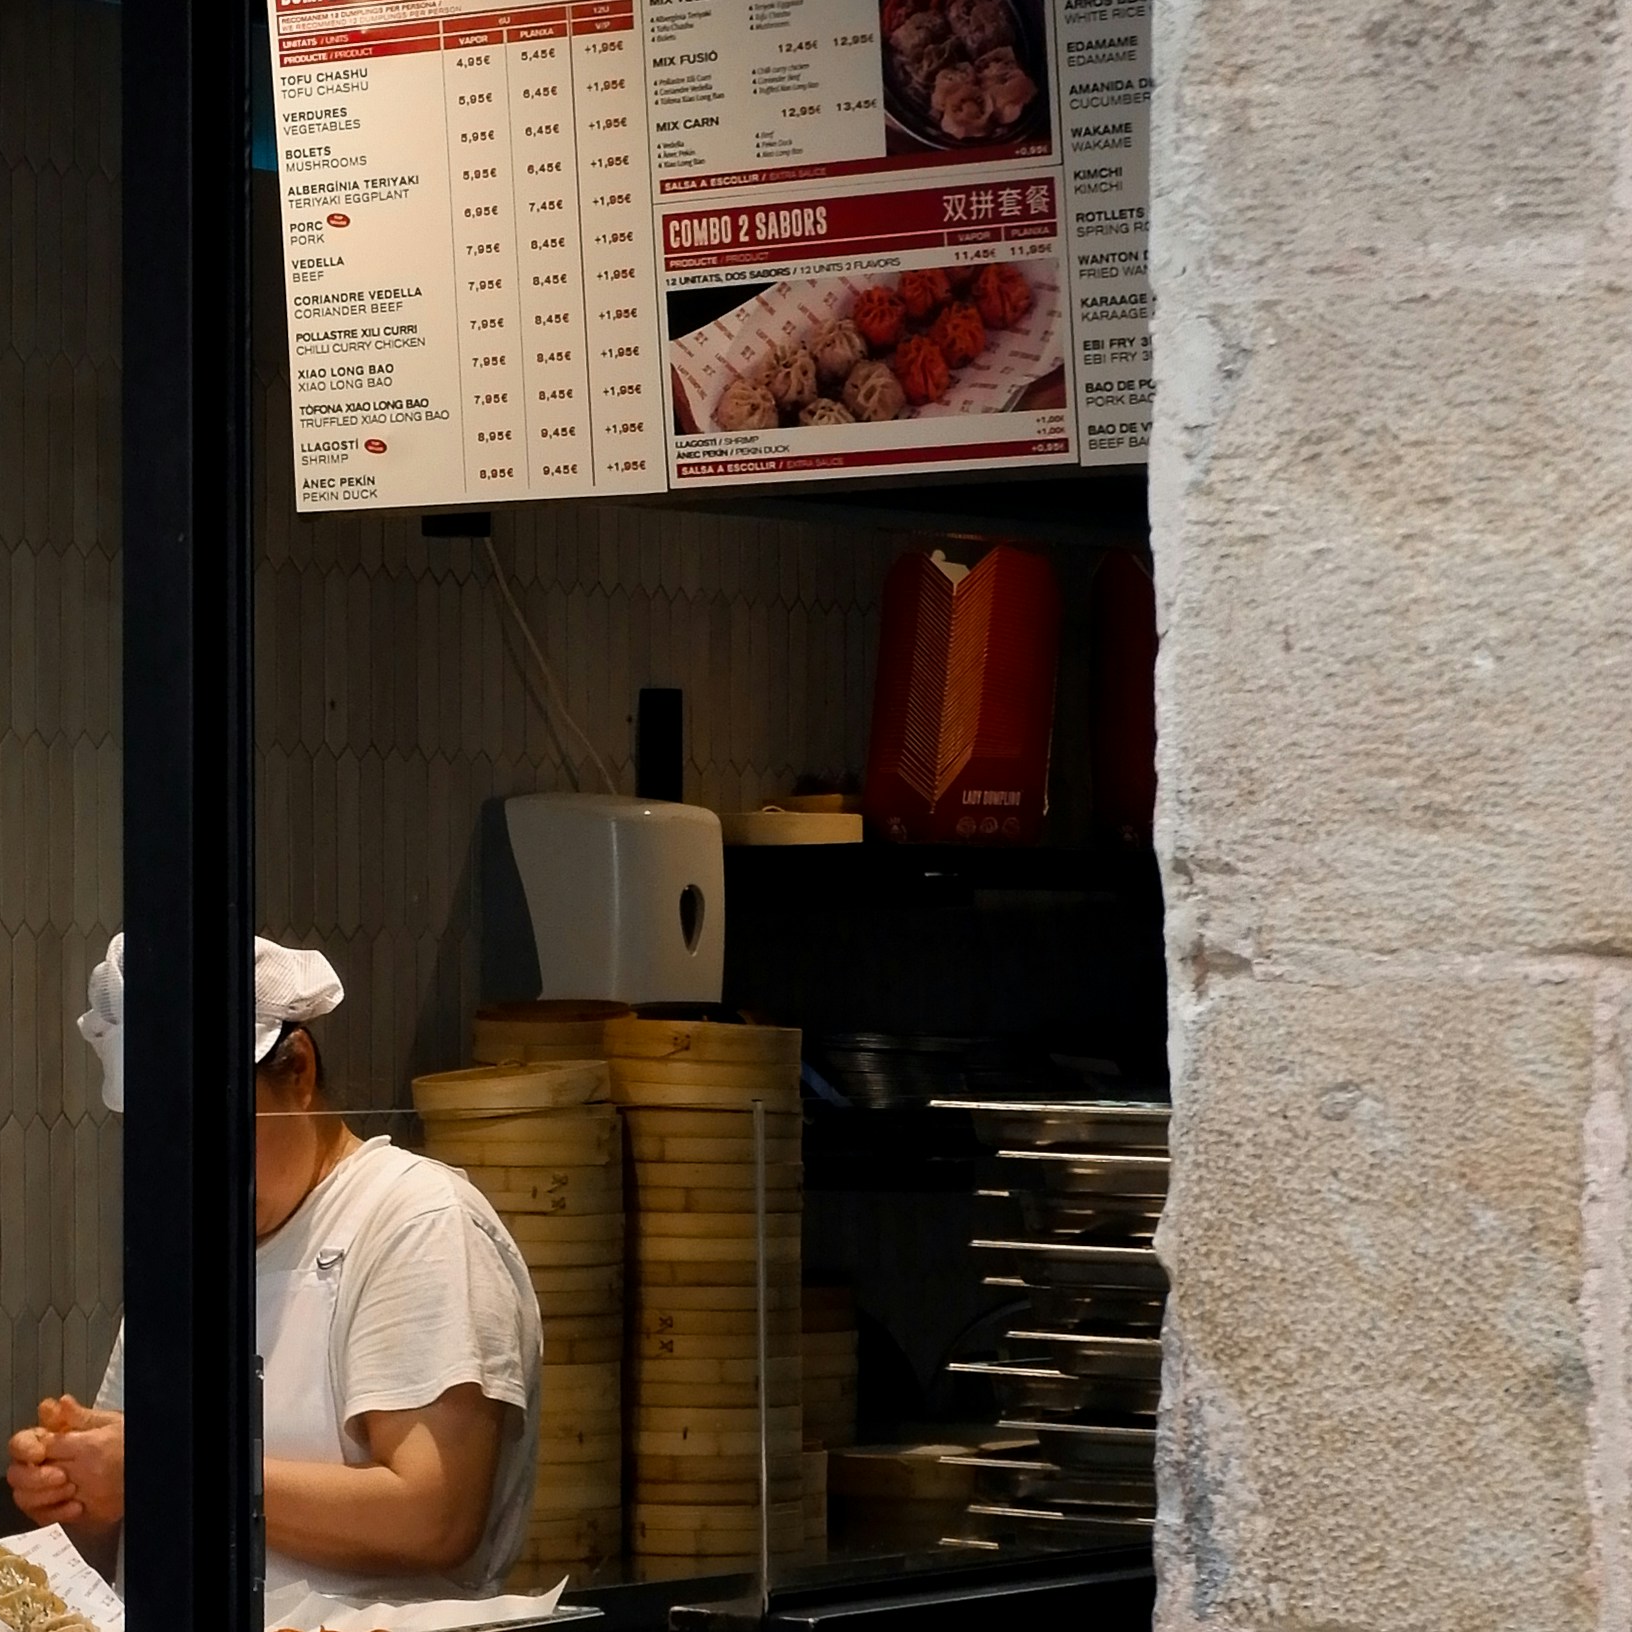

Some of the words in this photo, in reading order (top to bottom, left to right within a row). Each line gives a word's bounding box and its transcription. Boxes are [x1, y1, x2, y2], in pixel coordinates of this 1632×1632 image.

[1066, 35, 1137, 52] EDAMAME
[456, 54, 490, 68] 4,95€
[1067, 49, 1136, 67] EDAMAME
[280, 73, 311, 86] TOFU
[316, 67, 367, 82] CHASHU
[280, 86, 312, 99] TOFU
[316, 81, 368, 95] CHASHU
[1069, 79, 1134, 95] AMANIDA
[458, 92, 492, 105] 5,95€
[282, 107, 347, 122] VERDURES
[283, 118, 360, 135] VEGETABLES
[656, 120, 679, 132] MIX
[682, 116, 719, 129] CARN
[1070, 122, 1132, 137] WAKAME
[460, 129, 494, 143] 5,95€
[1071, 136, 1131, 152] WAKAME
[285, 145, 331, 159] BOLETS
[285, 155, 366, 171] MUSHROOMS
[462, 167, 496, 181] 5,95€
[1073, 166, 1122, 180] KIMCHI
[287, 180, 359, 196] ALBERGÍNIA
[363, 174, 418, 188] TERIYAKI
[664, 180, 696, 191] SALSA
[699, 179, 707, 187] A
[710, 173, 758, 186] ESCOLLIR
[1074, 181, 1122, 194] KIMCHI
[288, 195, 340, 208] TERIYAKI
[344, 188, 409, 204] EGGPLANT
[942, 184, 1049, 221] 双拼套餐
[464, 205, 498, 218] 6,95€
[1075, 206, 1144, 222] ROTLLETS
[289, 220, 322, 232] PORC
[669, 215, 731, 248] COMBO
[738, 214, 749, 242] 2
[755, 206, 827, 240] SABORS
[1076, 222, 1129, 237] SPRING
[290, 233, 324, 245] PORK
[466, 242, 499, 256] 7,95€
[291, 256, 344, 269] VEDELLA
[1077, 251, 1138, 265] WANTON
[292, 270, 323, 282] BEEF
[1078, 266, 1118, 278] FRIED
[467, 278, 501, 291] 7,95€
[293, 291, 364, 306] CORIANDRE
[368, 286, 422, 300] VEDELLA
[1080, 293, 1147, 308] KARAAGE
[293, 304, 366, 319] CORIANDER
[370, 300, 402, 313] BEEF
[1081, 307, 1147, 321] KARAAGE
[469, 317, 503, 330] 7,95€
[295, 328, 357, 342] POLLASTRE
[360, 327, 380, 337] XILI
[383, 324, 417, 336] CURRI
[295, 344, 329, 355] CHILLI
[331, 340, 371, 353] CURRY
[374, 336, 425, 350] CHICKEN
[1083, 339, 1104, 350] EBI
[1109, 336, 1135, 348] FRY
[471, 355, 505, 368] 7,95€
[1083, 353, 1105, 365] EBI
[1110, 351, 1137, 362] FRY
[297, 368, 326, 379] XIAO
[330, 365, 364, 377] LONG
[368, 363, 394, 374] BAO
[298, 380, 326, 392] XIAO
[329, 378, 362, 390] LONG
[367, 376, 392, 387] BAO
[1085, 381, 1113, 393] BAO
[1117, 379, 1135, 391] DE
[473, 392, 507, 405] 7,95€
[1085, 394, 1124, 407] PORK
[298, 403, 343, 415] TÒFONA
[344, 401, 370, 412] XIAO
[372, 399, 403, 411] LONG
[405, 397, 429, 408] BAO
[299, 415, 358, 428] TRUFFLED
[361, 413, 386, 424] XIAO
[389, 411, 422, 423] LONG
[424, 409, 449, 420] BAO
[1087, 423, 1116, 435] BAO
[1119, 422, 1137, 433] DE
[477, 429, 511, 443] 8,95€
[1088, 437, 1124, 449] BEEF
[300, 438, 358, 452] LLAGOSTÍ
[301, 453, 348, 465] SHRIMP
[479, 467, 513, 479] 8,95€
[681, 465, 714, 475] SALSA
[716, 464, 724, 472] A
[726, 461, 775, 472] ESCOLLIR
[302, 477, 335, 489] ÀNEC
[339, 474, 375, 486] PEKÍN
[302, 491, 338, 501] PEKIN
[342, 488, 377, 500] DUCK
